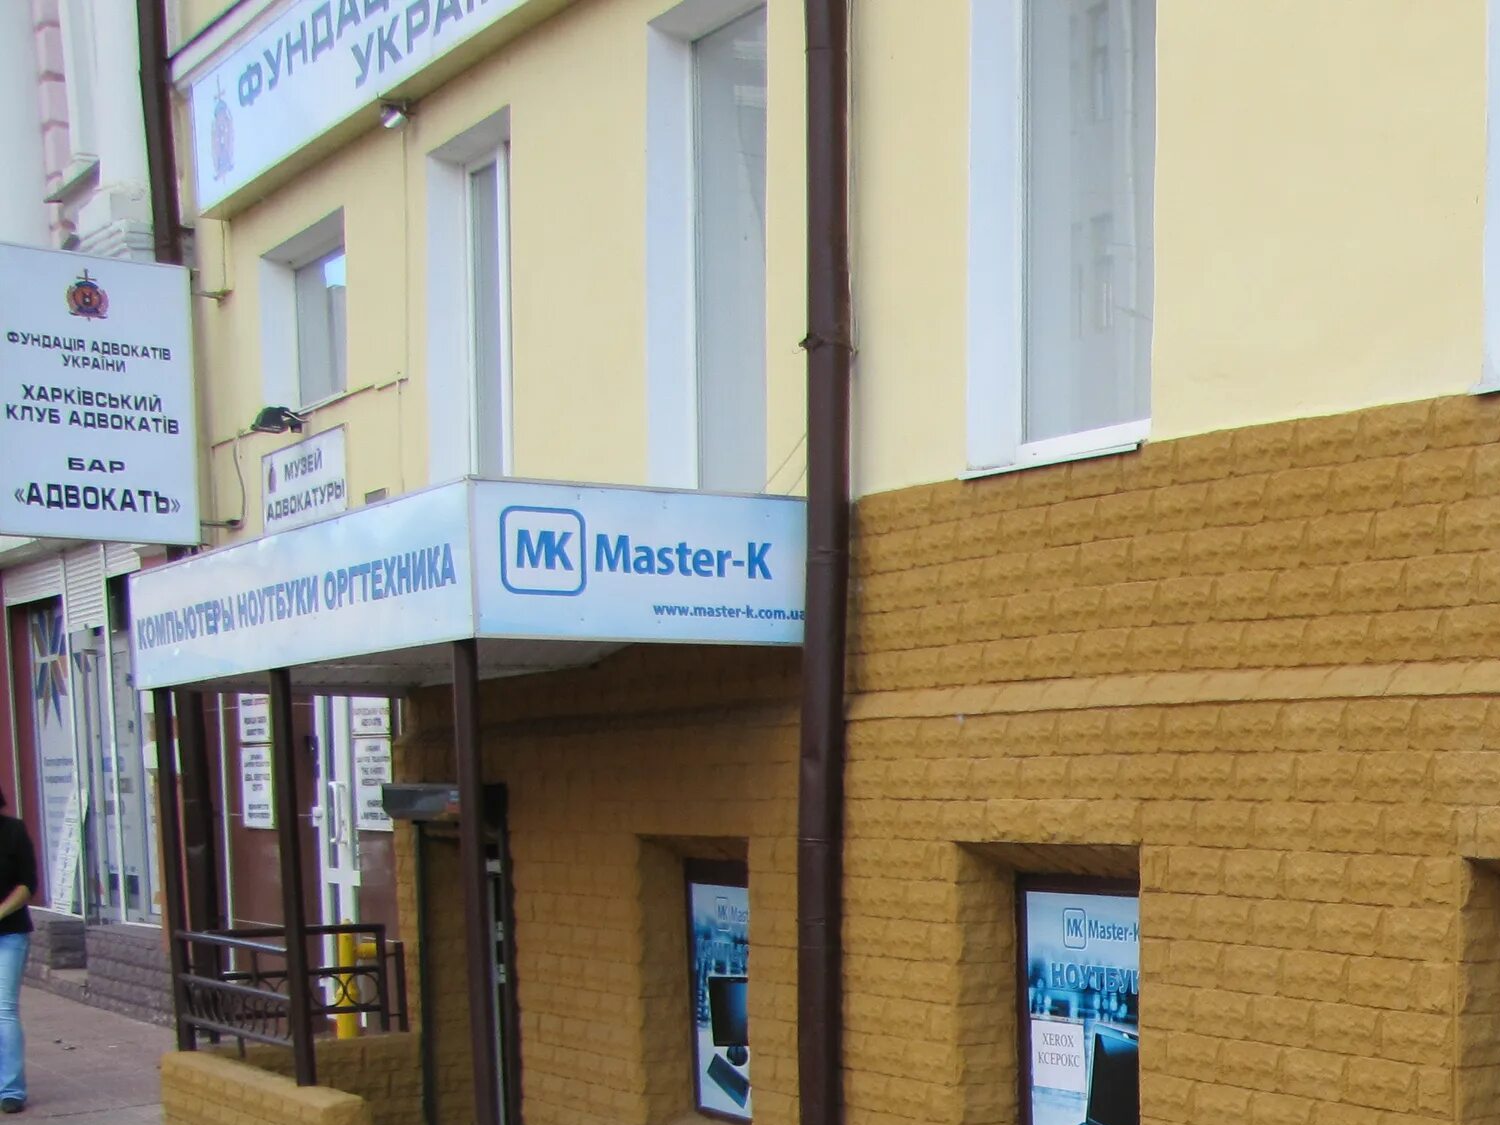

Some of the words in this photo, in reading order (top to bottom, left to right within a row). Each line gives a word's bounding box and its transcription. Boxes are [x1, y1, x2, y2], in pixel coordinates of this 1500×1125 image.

[351, 0, 489, 89] УКРА
[7, 331, 86, 352] ФУНДАЦІЯ
[91, 340, 171, 360] АДВОКАТІВ
[62, 353, 127, 373] УКРАЇНИ
[6, 403, 61, 424] КЛУБ
[67, 457, 125, 474] БАР
[284, 448, 323, 481] МУЗЕЙ
[266, 478, 346, 521] АДВОКАТУРЫ
[516, 529, 574, 571] MK
[594, 533, 773, 580] Master-K
[136, 596, 235, 650] КОМПЬЮТЕРЫ
[237, 575, 319, 628] НОУТБУКИ
[323, 543, 457, 610] ОРГТЕХНИКА
[1066, 918, 1083, 938] MK
[1042, 1032, 1075, 1048] XEROX
[1037, 1051, 1081, 1068] КСЕРОКС
